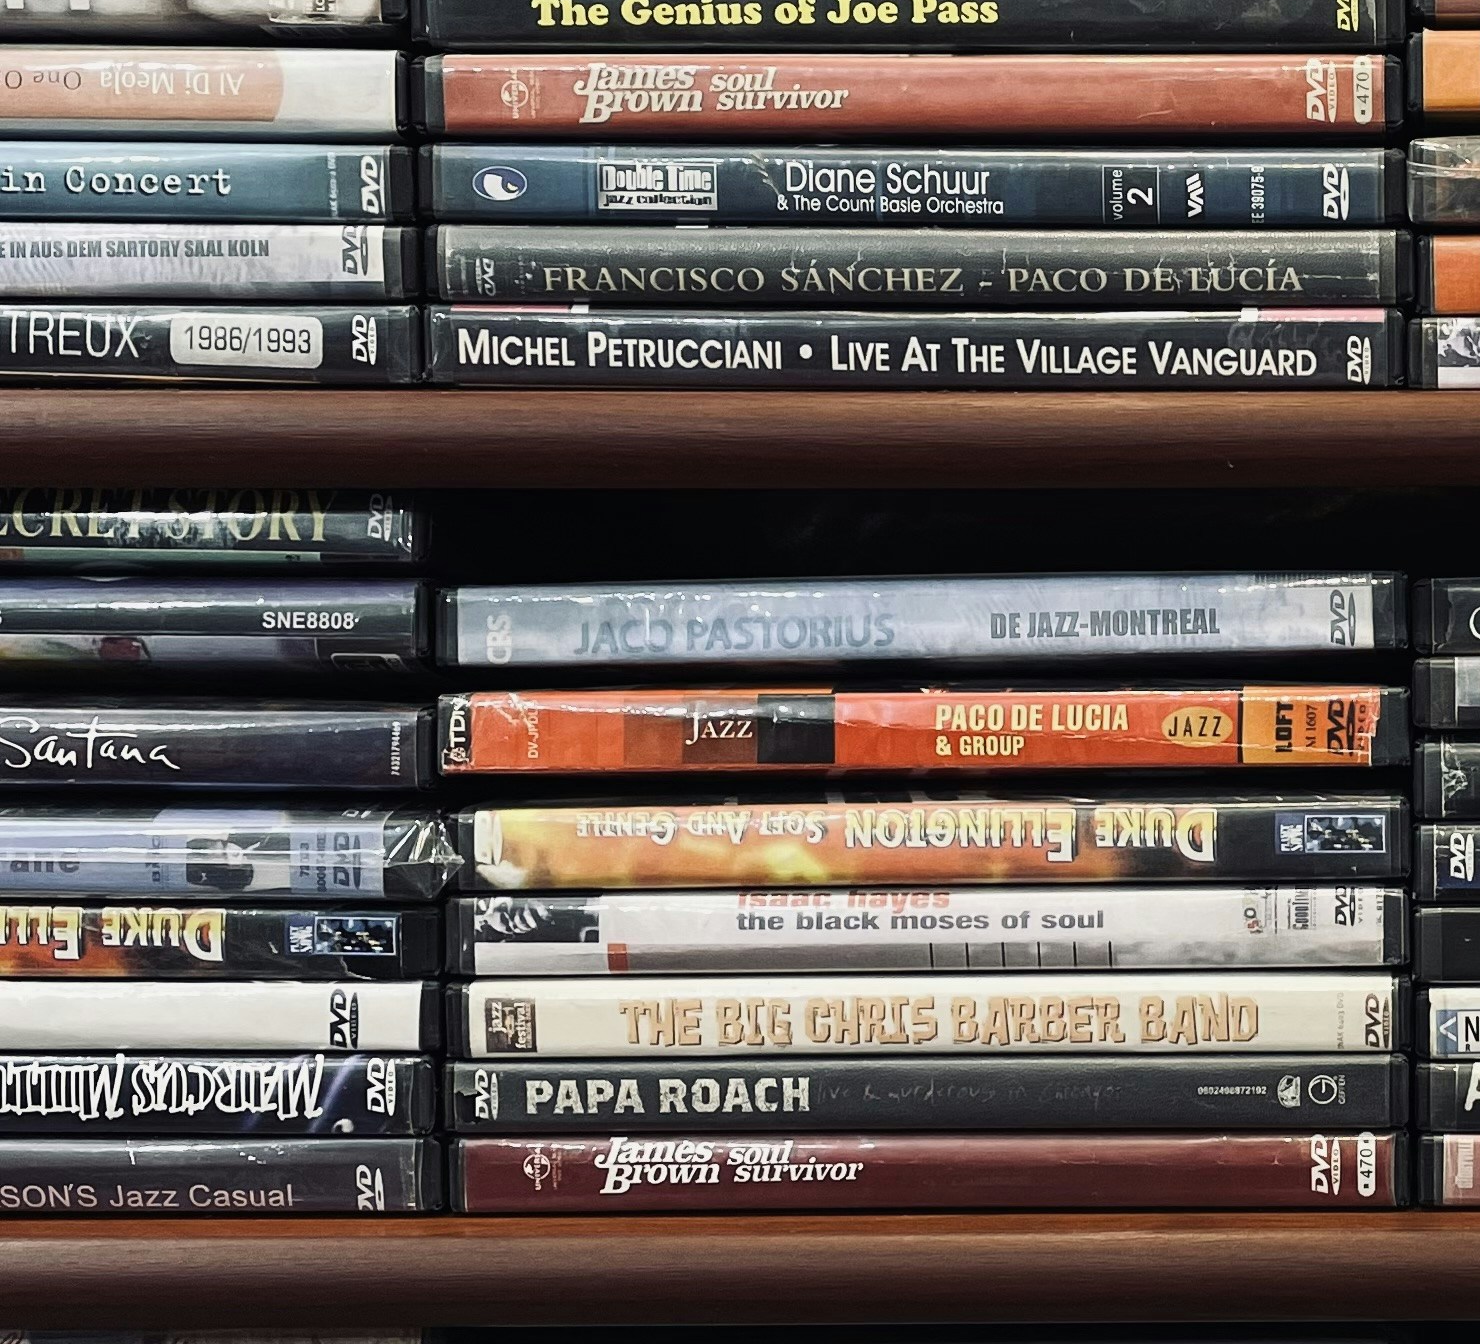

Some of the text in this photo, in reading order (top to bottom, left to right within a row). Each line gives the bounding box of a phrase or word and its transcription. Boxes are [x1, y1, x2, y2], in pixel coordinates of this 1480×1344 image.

[1, 166, 232, 196] in Concert
[785, 163, 989, 195] Diane Schuur
[777, 195, 1003, 214] & The Count Basie Orchestra
[184, 326, 310, 353] 1986/1993
[262, 612, 355, 629] SNE8808
[936, 705, 1128, 731] PACO DE LUCIA
[1168, 716, 1222, 738] JAZZ
[936, 737, 1024, 756] & GROUP
[525, 1077, 811, 1115] PAPA ROACH
